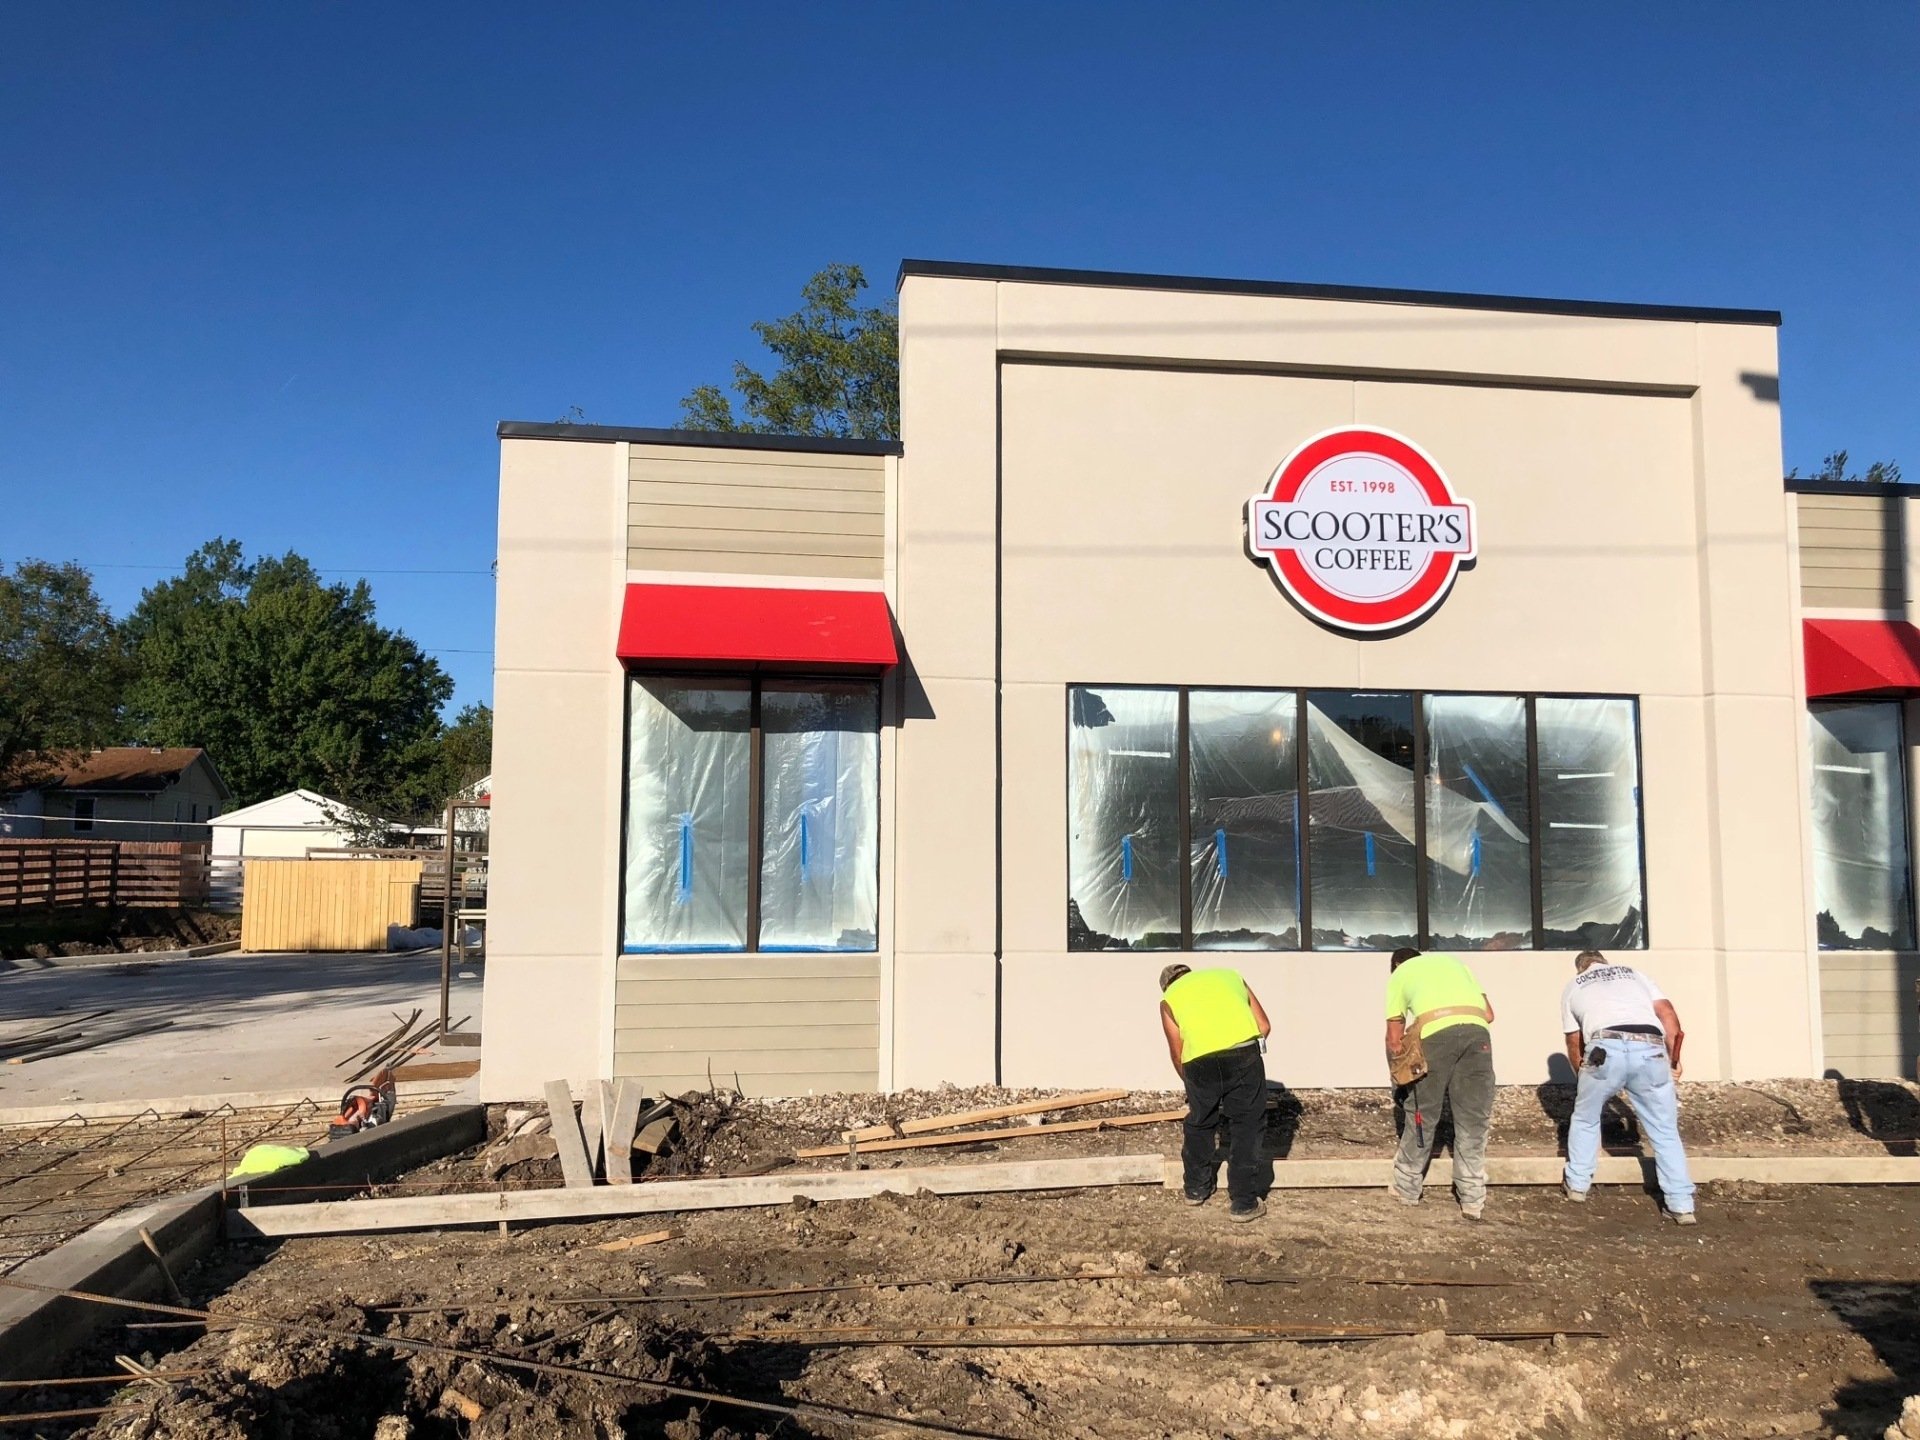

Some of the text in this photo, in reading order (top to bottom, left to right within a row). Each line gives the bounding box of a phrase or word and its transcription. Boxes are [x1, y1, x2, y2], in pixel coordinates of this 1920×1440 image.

[1330, 480, 1395, 493] EST. 1998
[1264, 509, 1462, 544] SCOOTER'S
[1315, 547, 1412, 571] COFFEE
[1575, 966, 1633, 985] CONSTRUCTION
